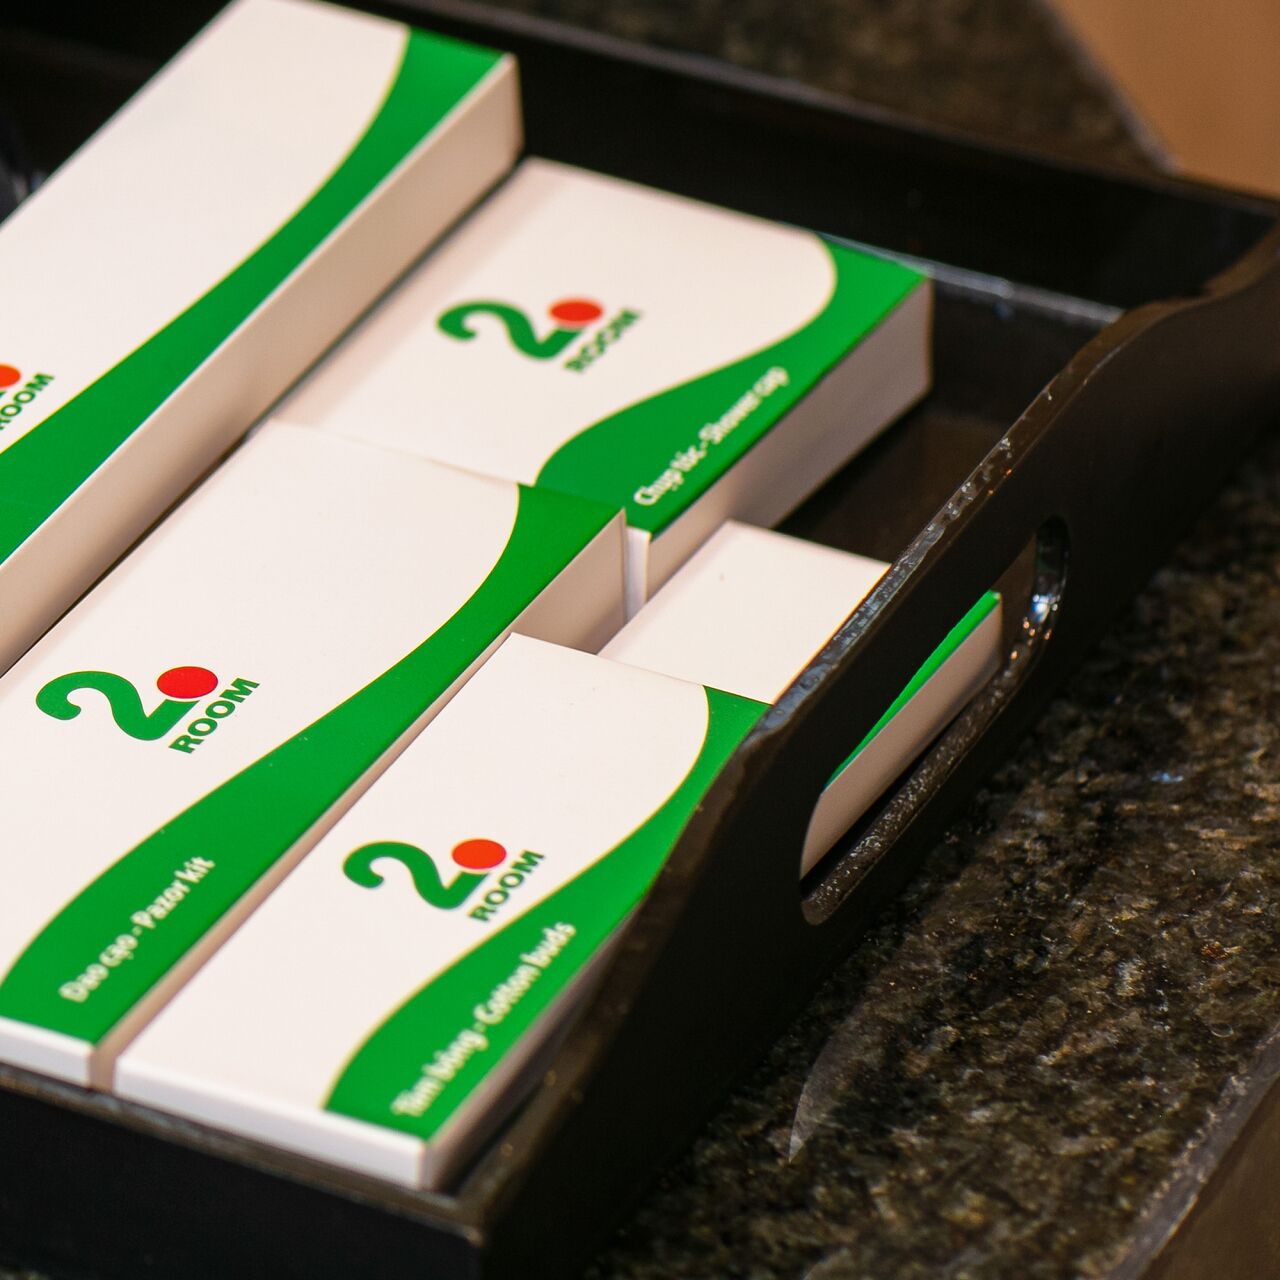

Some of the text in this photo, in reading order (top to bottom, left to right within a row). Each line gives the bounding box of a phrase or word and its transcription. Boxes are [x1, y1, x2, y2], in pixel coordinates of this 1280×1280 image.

[563, 308, 641, 373] ROOM
[168, 678, 260, 754] ROOM
[468, 850, 546, 922] ROOM
[58, 963, 109, 1003] Dao
[174, 856, 216, 884] kit
[473, 962, 541, 1024] Cotton
[519, 921, 577, 969] buds
